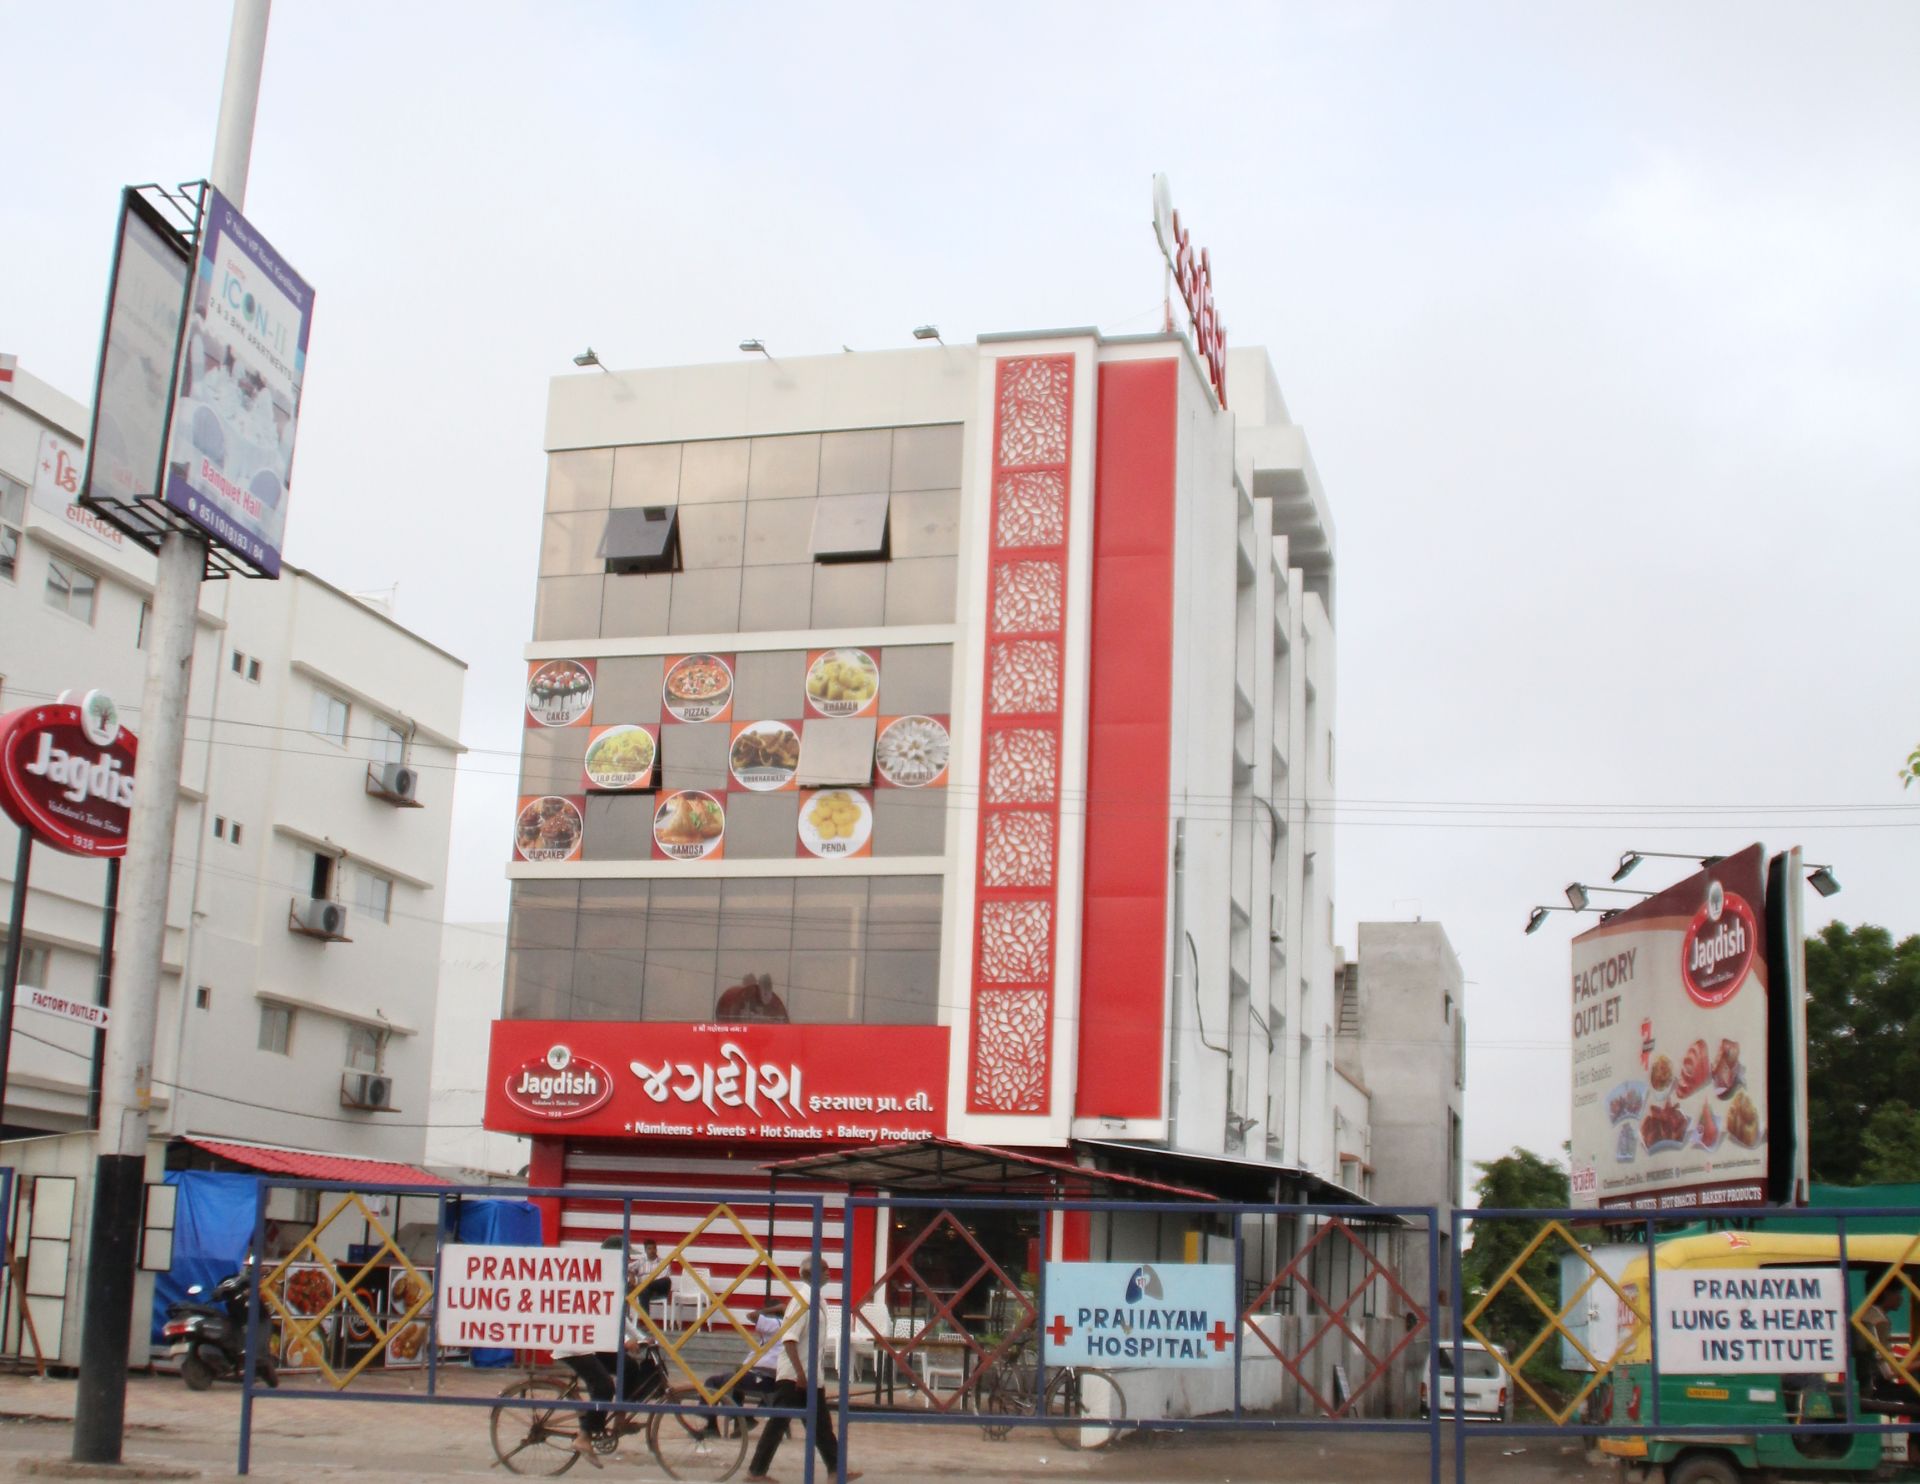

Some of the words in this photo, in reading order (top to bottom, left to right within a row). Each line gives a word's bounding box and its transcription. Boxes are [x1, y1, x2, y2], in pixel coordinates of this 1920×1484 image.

[202, 458, 241, 504] Banquet
[243, 490, 262, 520] Hall
[546, 711, 570, 722] CAKES
[684, 707, 710, 718] PIZZAS
[25, 731, 135, 809] Jagdis
[528, 850, 565, 860] CUPCAKES
[671, 844, 704, 855] SAMOSA
[821, 843, 847, 853] PENDA
[1691, 917, 1746, 975] Jagdish
[1574, 946, 1637, 1004] FACTORY
[32, 991, 70, 1013] FACTORY
[70, 1002, 99, 1021] OUTLET
[1574, 994, 1622, 1039] OUTLET
[517, 1071, 597, 1099] Jagdish
[629, 1042, 807, 1119] જગદીશ
[808, 1094, 873, 1113] ફરસાણ
[635, 1121, 693, 1136] Namkeens
[706, 1123, 747, 1137] Sweets
[760, 1125, 783, 1138] Hot
[783, 1125, 823, 1139] Snacks
[837, 1125, 878, 1141] Bakery
[880, 1127, 932, 1141] Products
[466, 1256, 602, 1282] PRANAYAM
[447, 1287, 511, 1311] LUNG
[517, 1288, 534, 1313] &
[540, 1289, 615, 1315] HEART
[1693, 1278, 1822, 1300] PRANAYAM
[1671, 1309, 1731, 1330] LUNG
[1739, 1310, 1757, 1330] &
[1762, 1309, 1839, 1331] HEART
[460, 1321, 595, 1345] INSTITUTE
[1087, 1335, 1208, 1360] HOSPITAL
[1701, 1338, 1835, 1362] INSTITUTE
